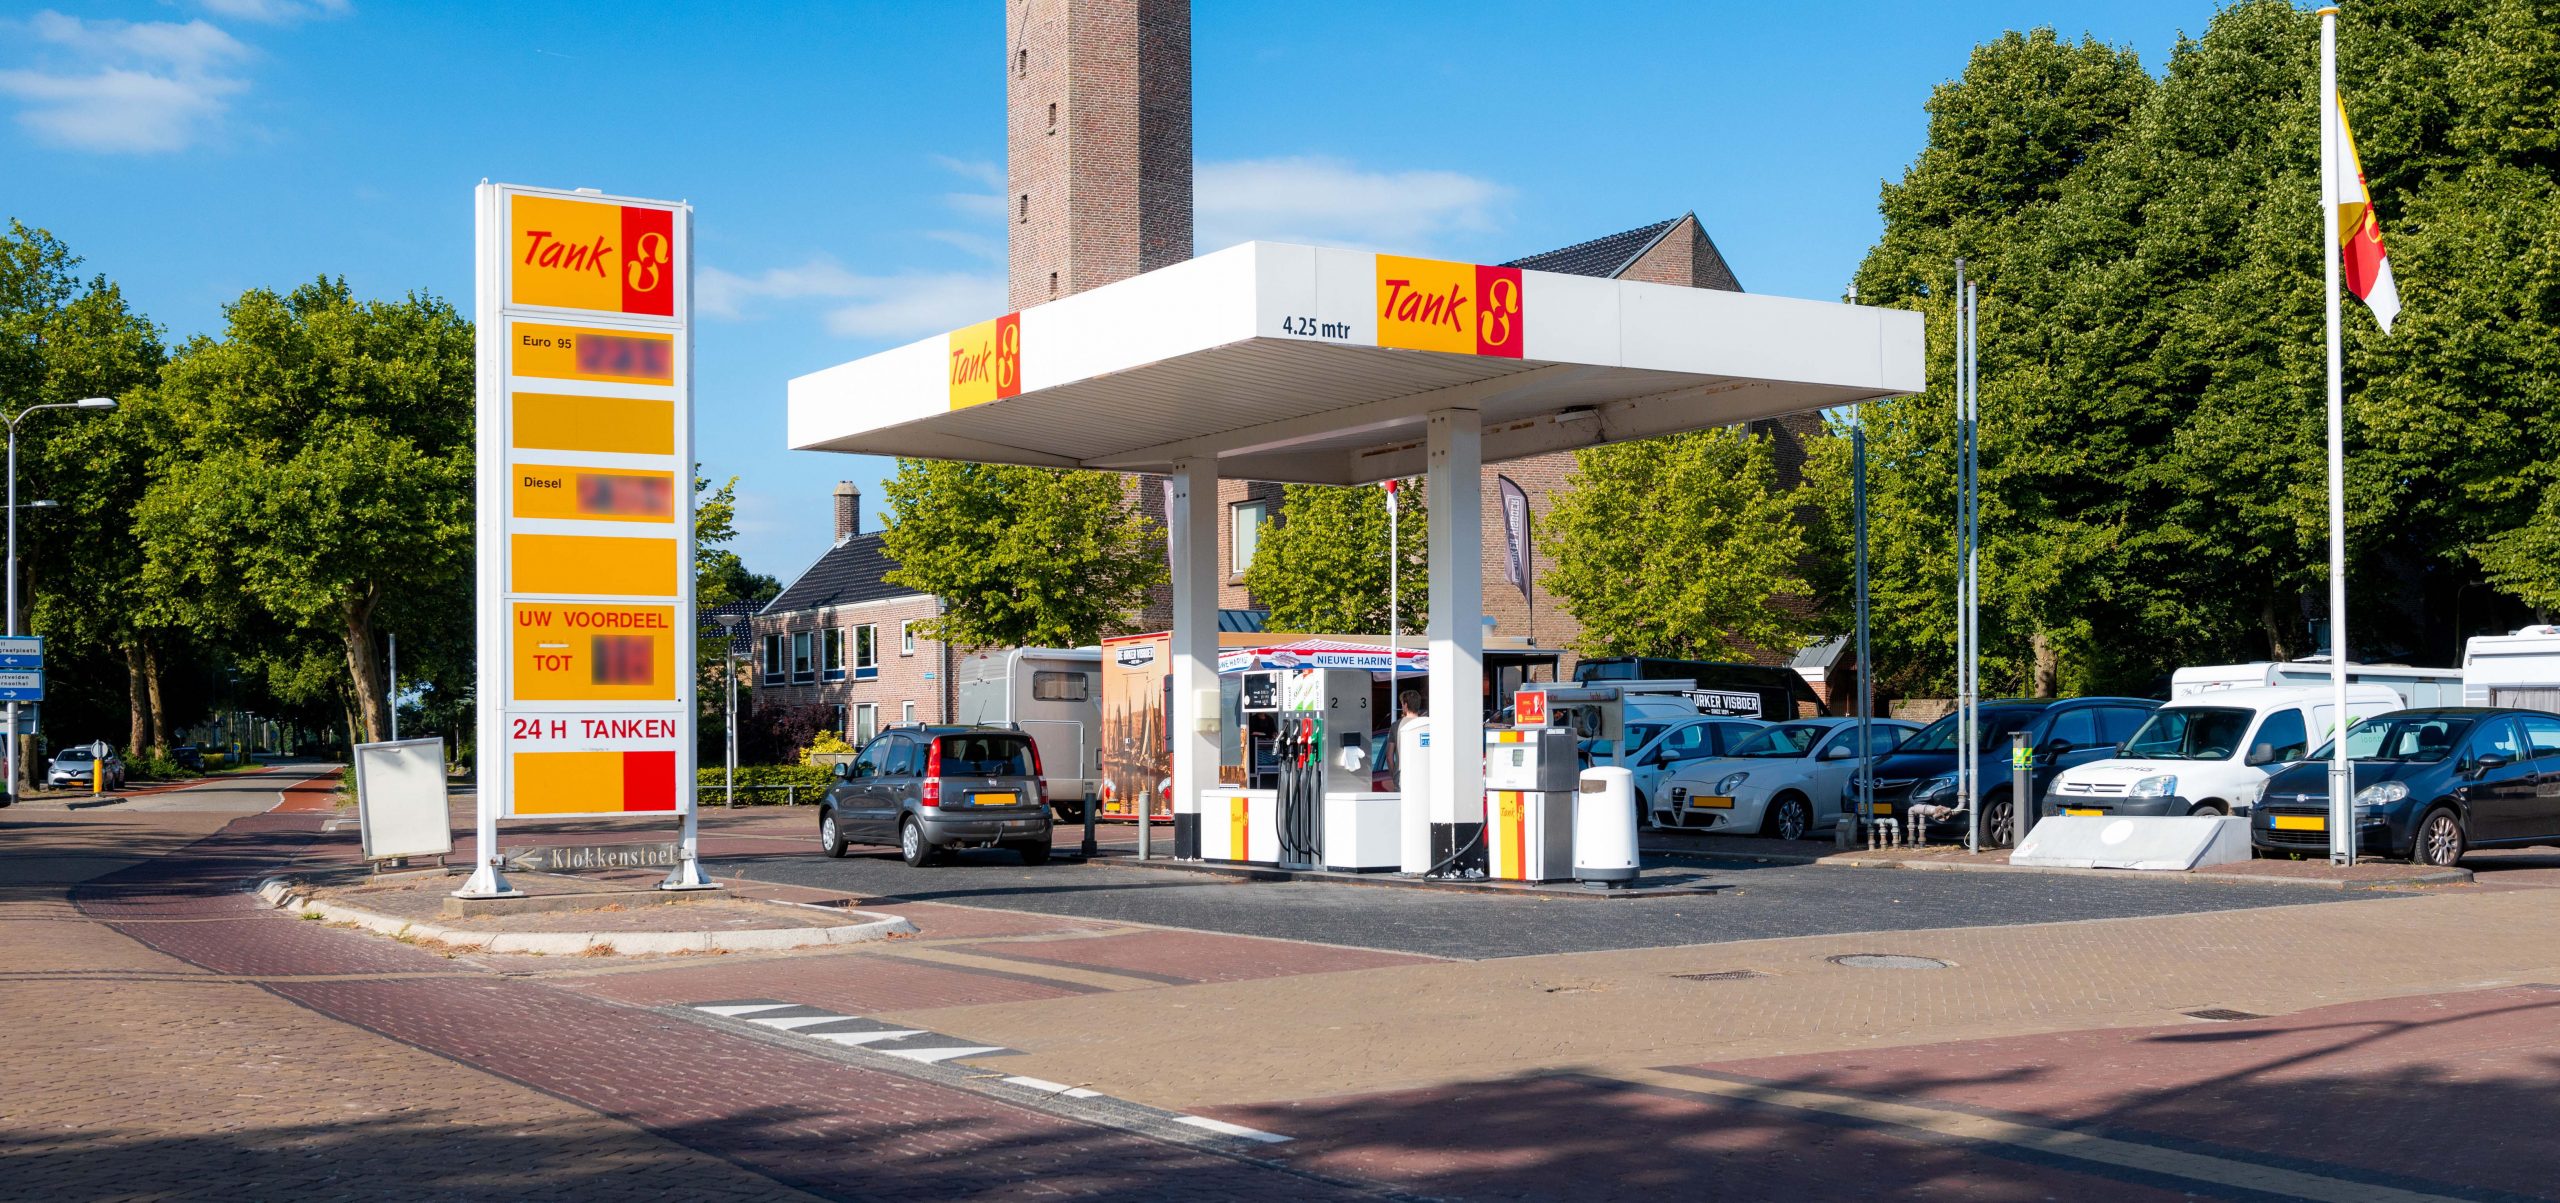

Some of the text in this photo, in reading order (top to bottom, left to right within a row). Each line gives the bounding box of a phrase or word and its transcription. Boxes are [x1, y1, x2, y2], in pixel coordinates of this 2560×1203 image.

[524, 230, 613, 278] Tank
[1383, 279, 1468, 333] Tank
[1283, 316, 1351, 340] 4.25 mtr
[523, 335, 572, 349] Euro 95
[952, 340, 992, 386] Tank
[524, 476, 562, 489] Diesel
[519, 610, 669, 629] UW VOORDEEL
[533, 654, 573, 672] TOT
[1317, 655, 1393, 666] NIEUWE HARING
[1331, 697, 1338, 709] 2
[1360, 697, 1367, 709] 3
[1722, 695, 1758, 711] VISBOER
[513, 718, 676, 739] 24 H TANKEN
[552, 844, 674, 868] Klokkenstoel
